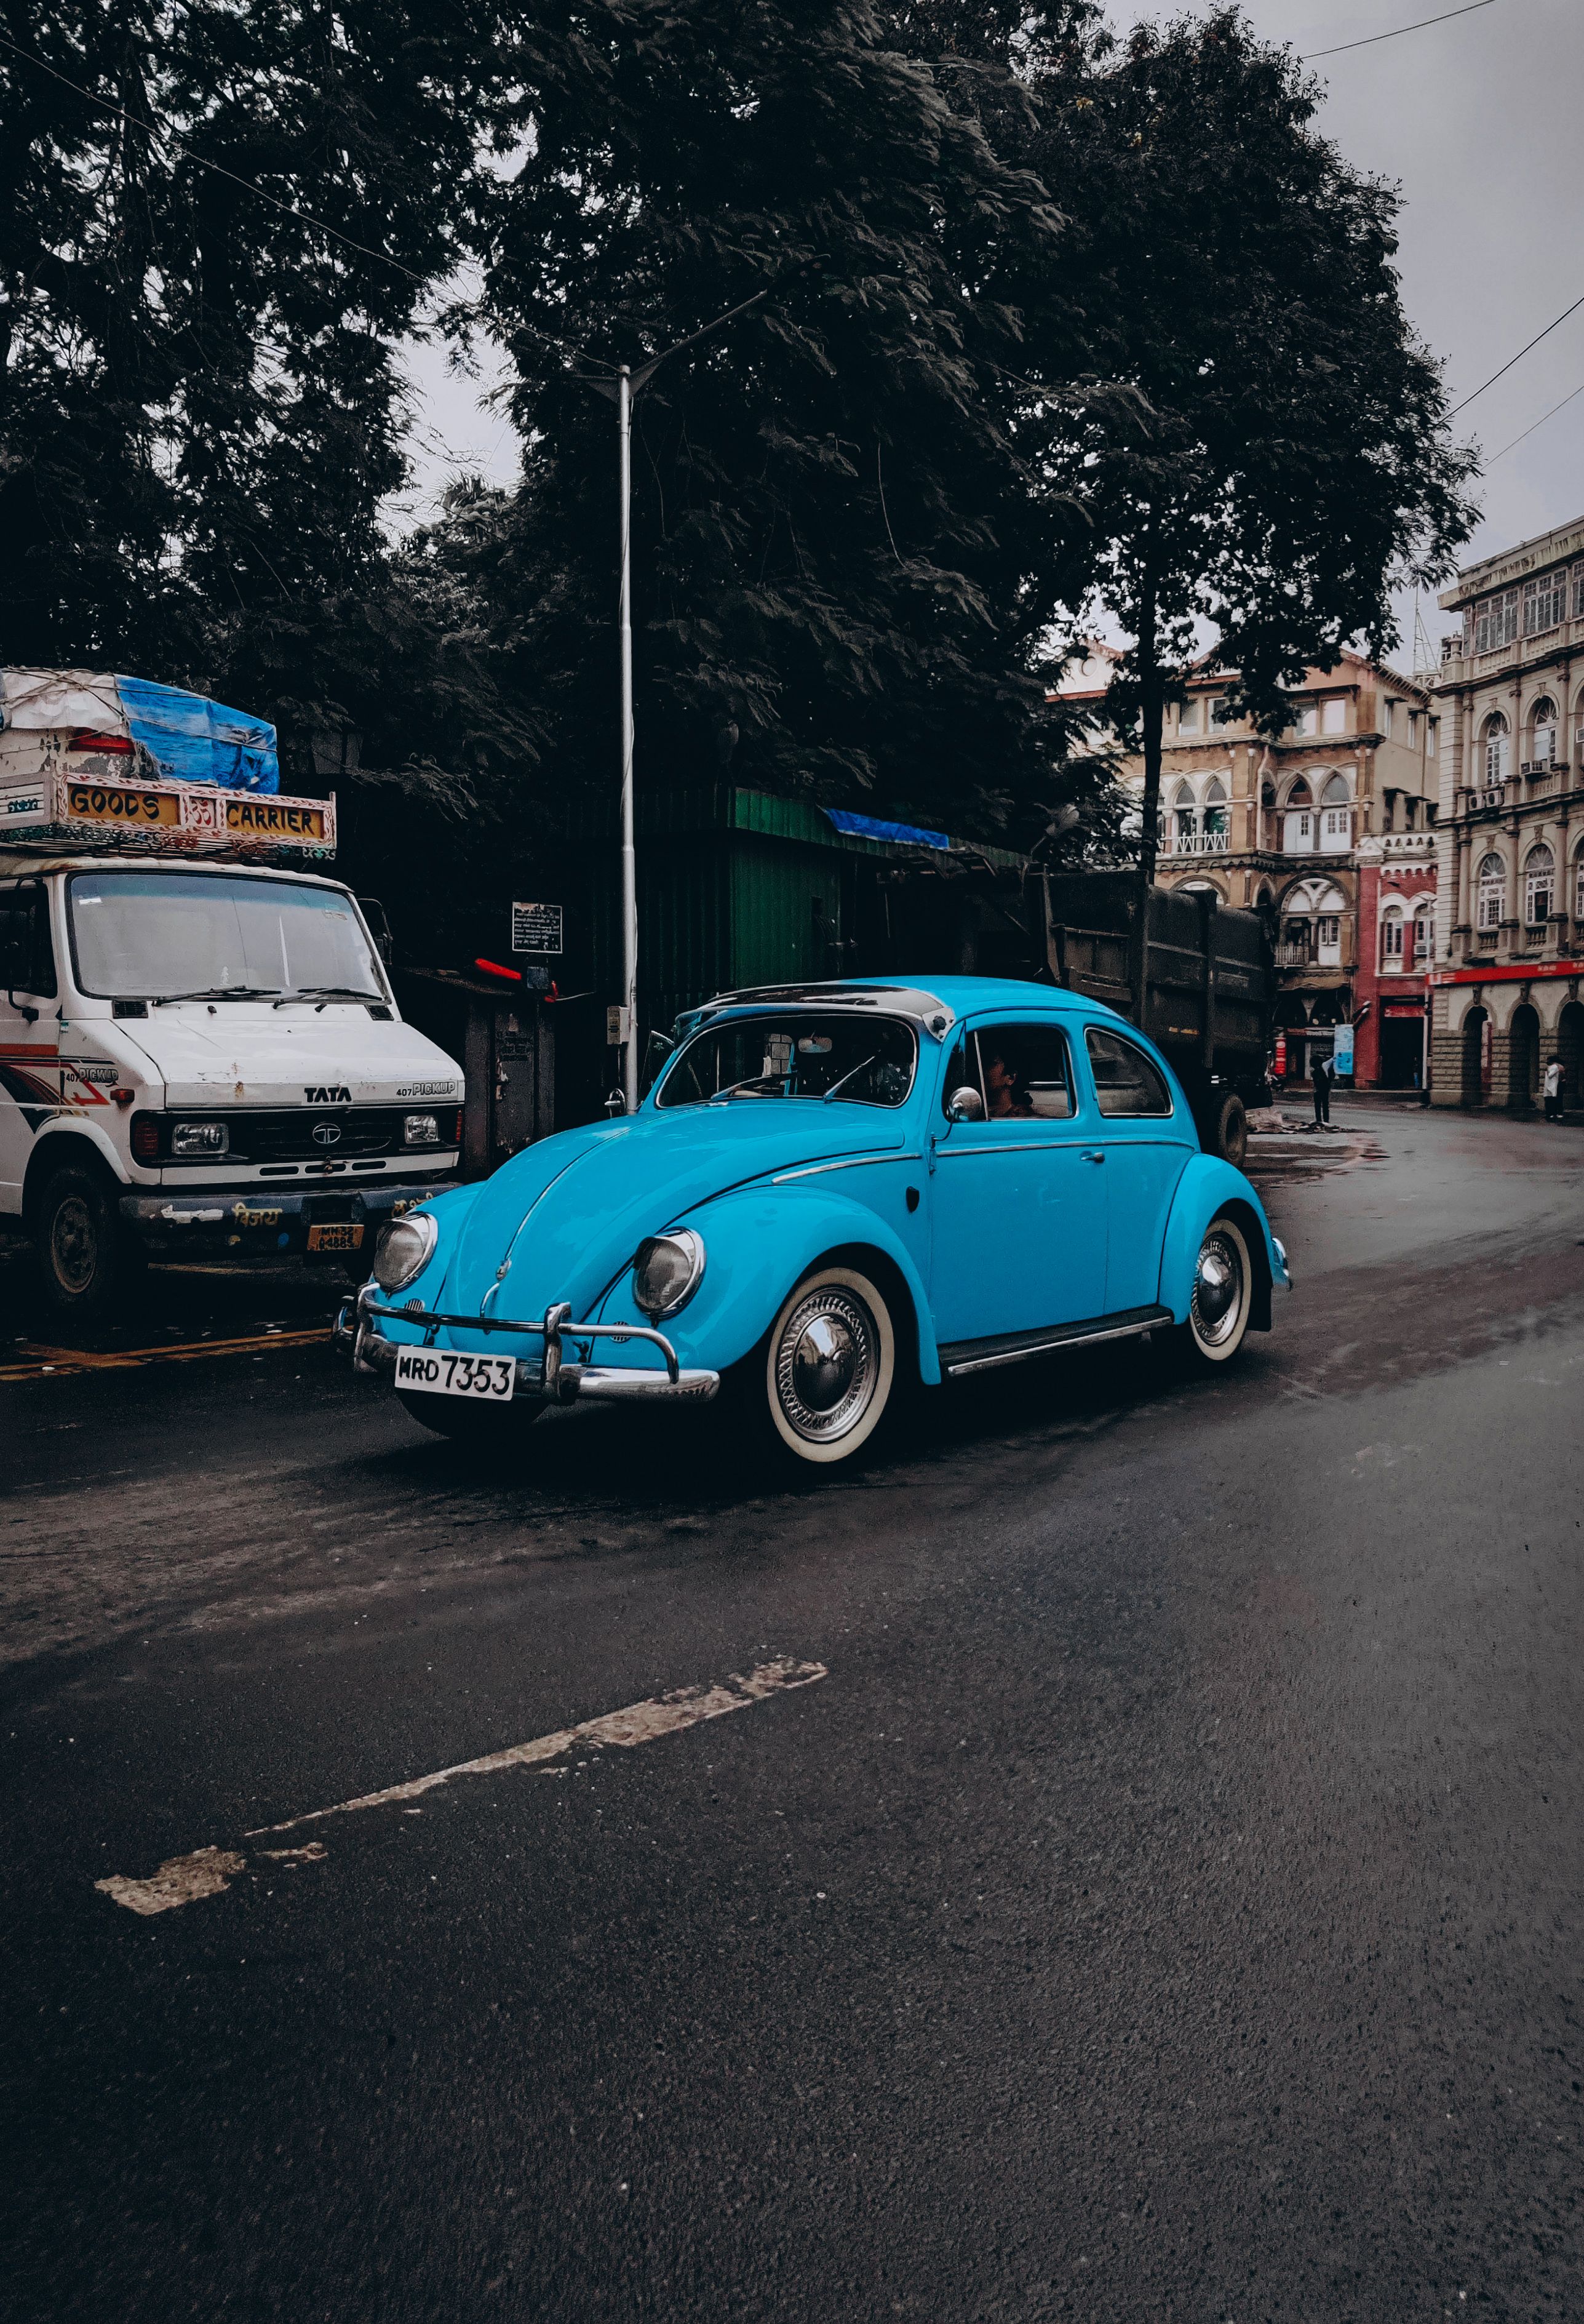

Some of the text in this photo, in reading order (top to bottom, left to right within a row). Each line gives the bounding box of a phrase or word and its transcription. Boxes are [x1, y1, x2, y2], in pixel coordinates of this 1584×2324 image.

[71, 787, 315, 836] GOODS CARRIER
[304, 1087, 352, 1103] TATA
[412, 1082, 456, 1096] PICKUP
[441, 1355, 512, 1396] 7353
